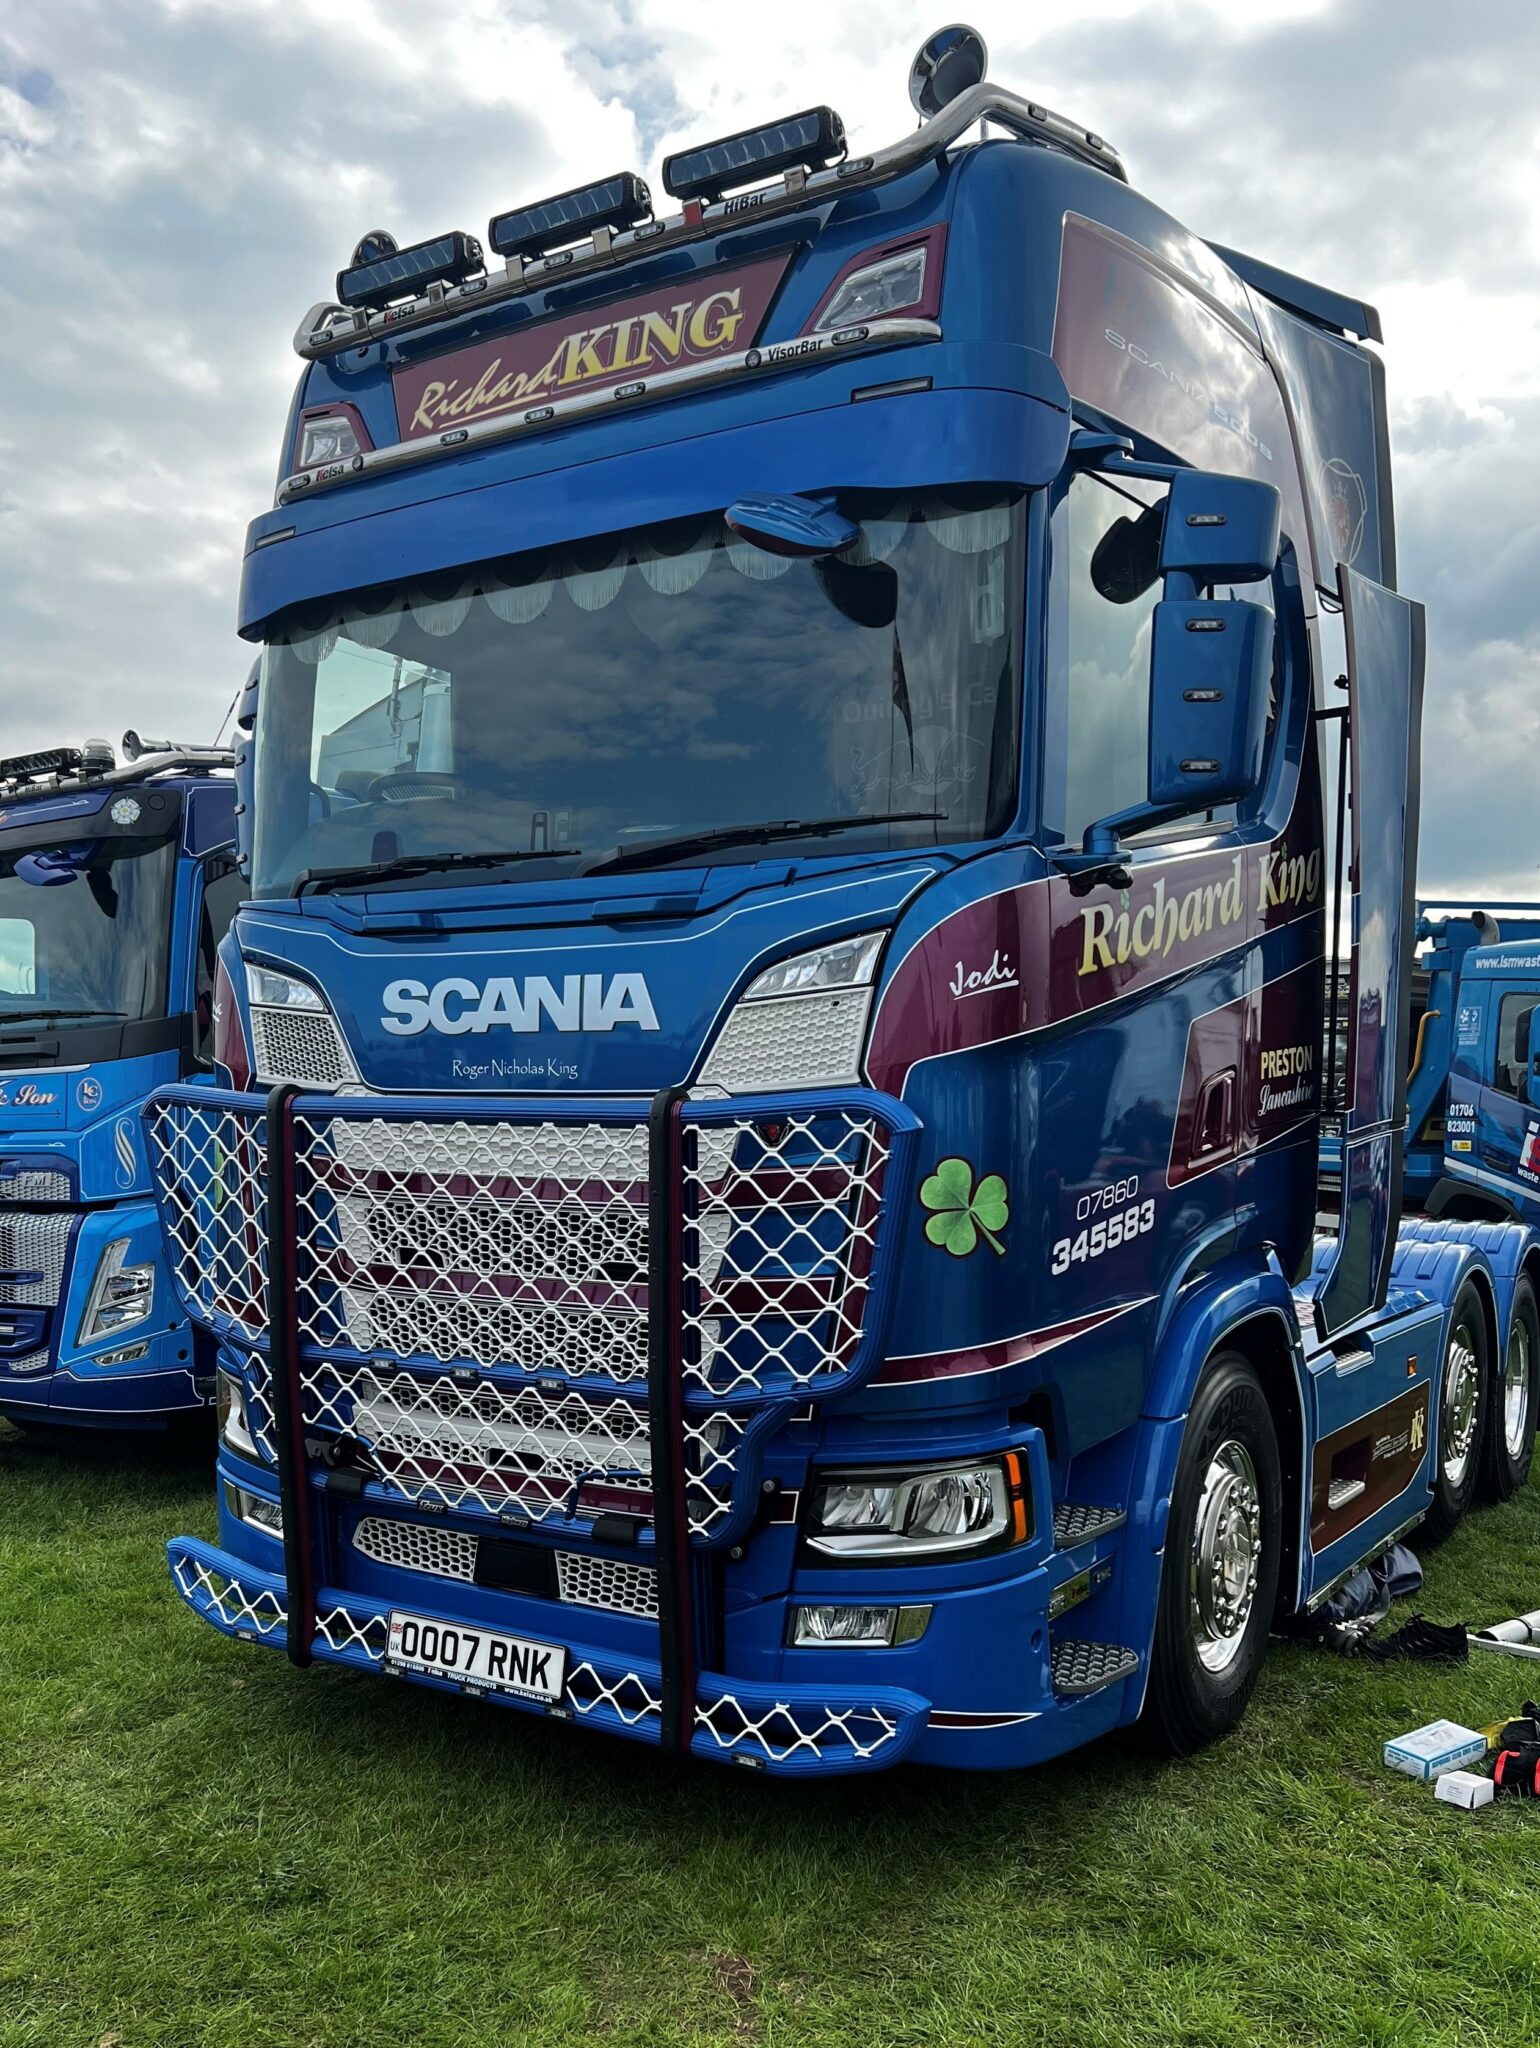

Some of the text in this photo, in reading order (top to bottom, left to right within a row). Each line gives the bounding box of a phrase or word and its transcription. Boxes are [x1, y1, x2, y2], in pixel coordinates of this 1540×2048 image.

[724, 192, 767, 215] HiBar
[384, 305, 415, 324] Kelsa
[410, 287, 745, 431] Richard KING
[768, 339, 824, 361] VisorBar
[1104, 328, 1207, 402] SCANIA
[316, 464, 345, 482] Kelsa
[1078, 845, 1321, 977] Richard King
[949, 949, 1017, 996] Jodi
[380, 973, 661, 1036] SCANIA
[453, 1058, 578, 1080] Roger Nicholas King
[1261, 1045, 1312, 1080] PRESTON
[15, 1084, 56, 1105] Son
[1258, 1075, 1313, 1117] Lancashire
[1450, 1104, 1474, 1116] 01706
[1447, 1120, 1475, 1133] 823001
[24, 1175, 46, 1186] FM
[1077, 1175, 1139, 1220] 07860
[1051, 1199, 1155, 1276] 345583
[390, 1640, 400, 1651] UK
[487, 1640, 552, 1690] RNK
[447, 1672, 466, 1683] TRUCK
[466, 1677, 497, 1690] PRODUCTS
